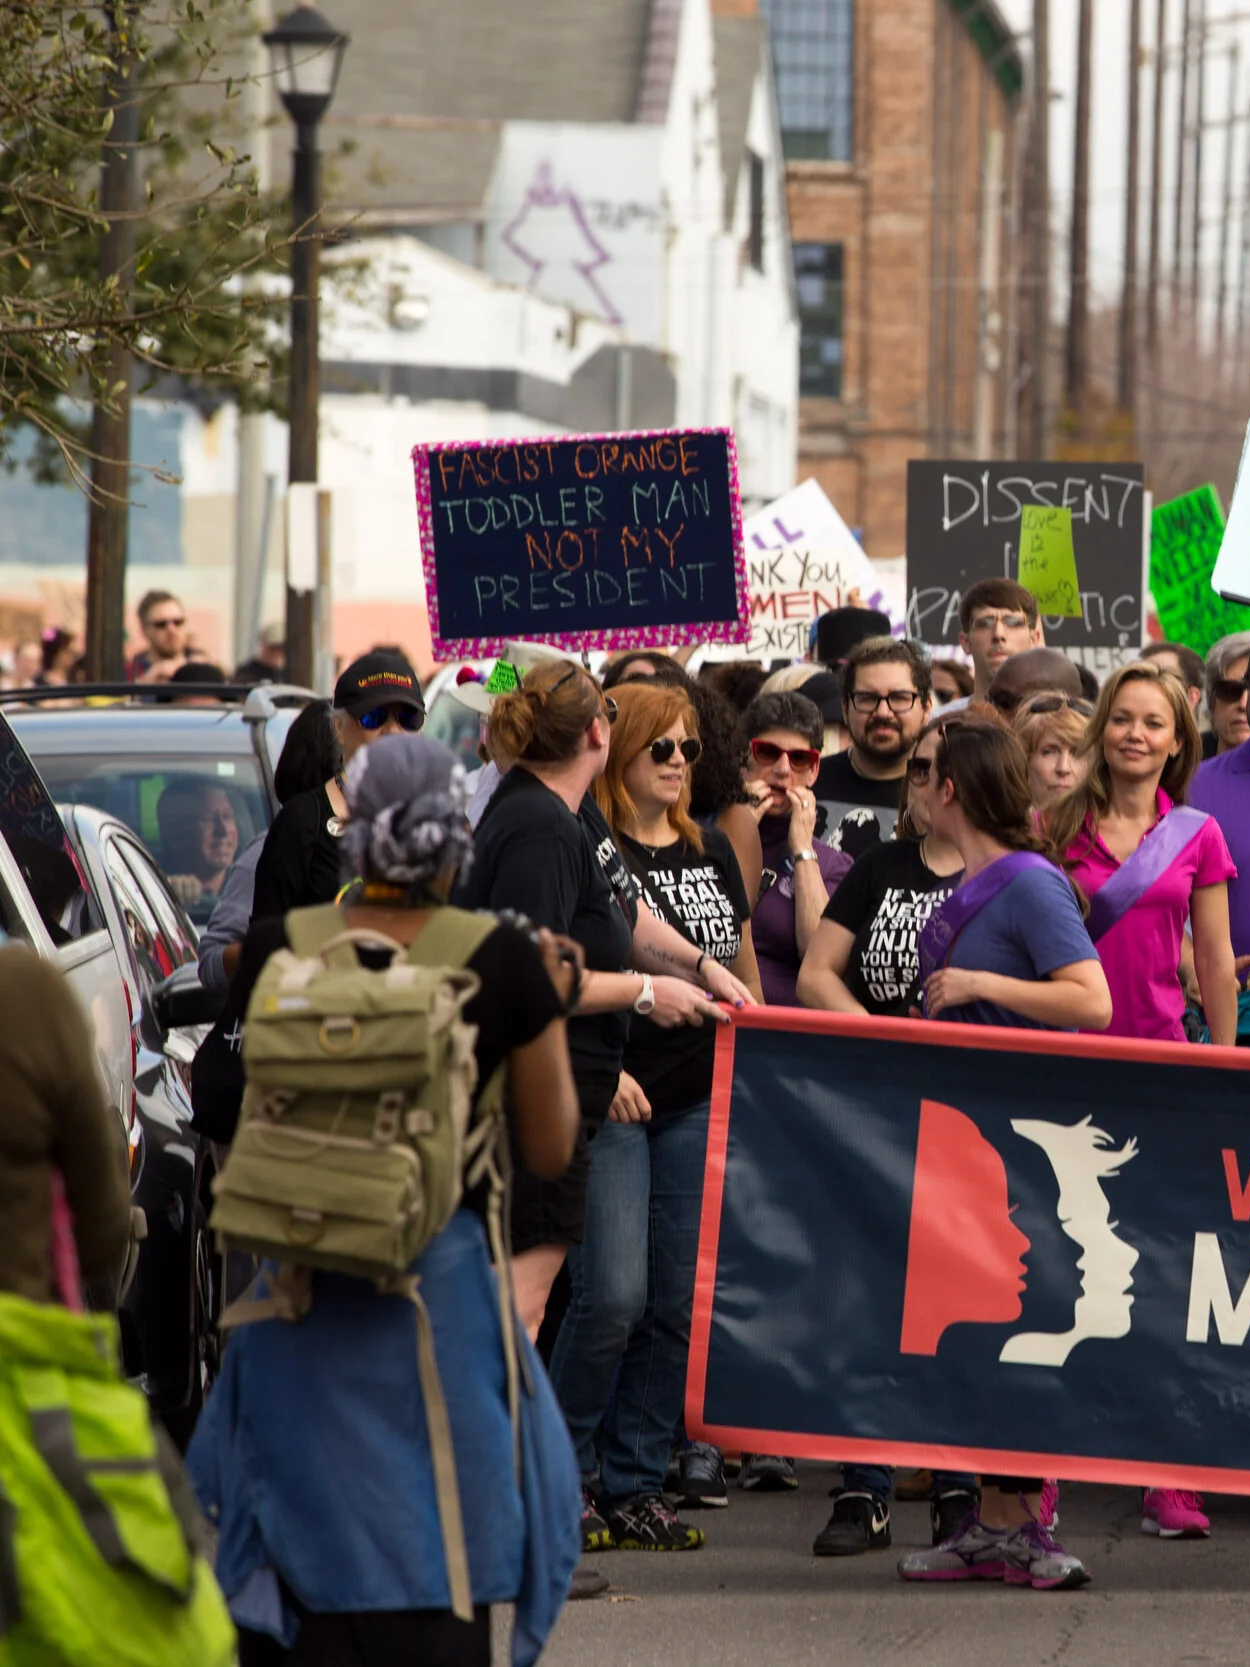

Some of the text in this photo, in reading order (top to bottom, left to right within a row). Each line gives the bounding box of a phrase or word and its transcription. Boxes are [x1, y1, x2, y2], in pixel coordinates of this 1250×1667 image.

[438, 437, 700, 492] FASCIST ORANGE
[439, 479, 711, 535] TODDLER MAN
[525, 523, 685, 571] NOT MY
[474, 562, 716, 616] PRESIDENT
[681, 866, 719, 884] ARE
[884, 887, 904, 902] IF
[861, 951, 892, 967] YOU
[861, 967, 896, 983] THE
